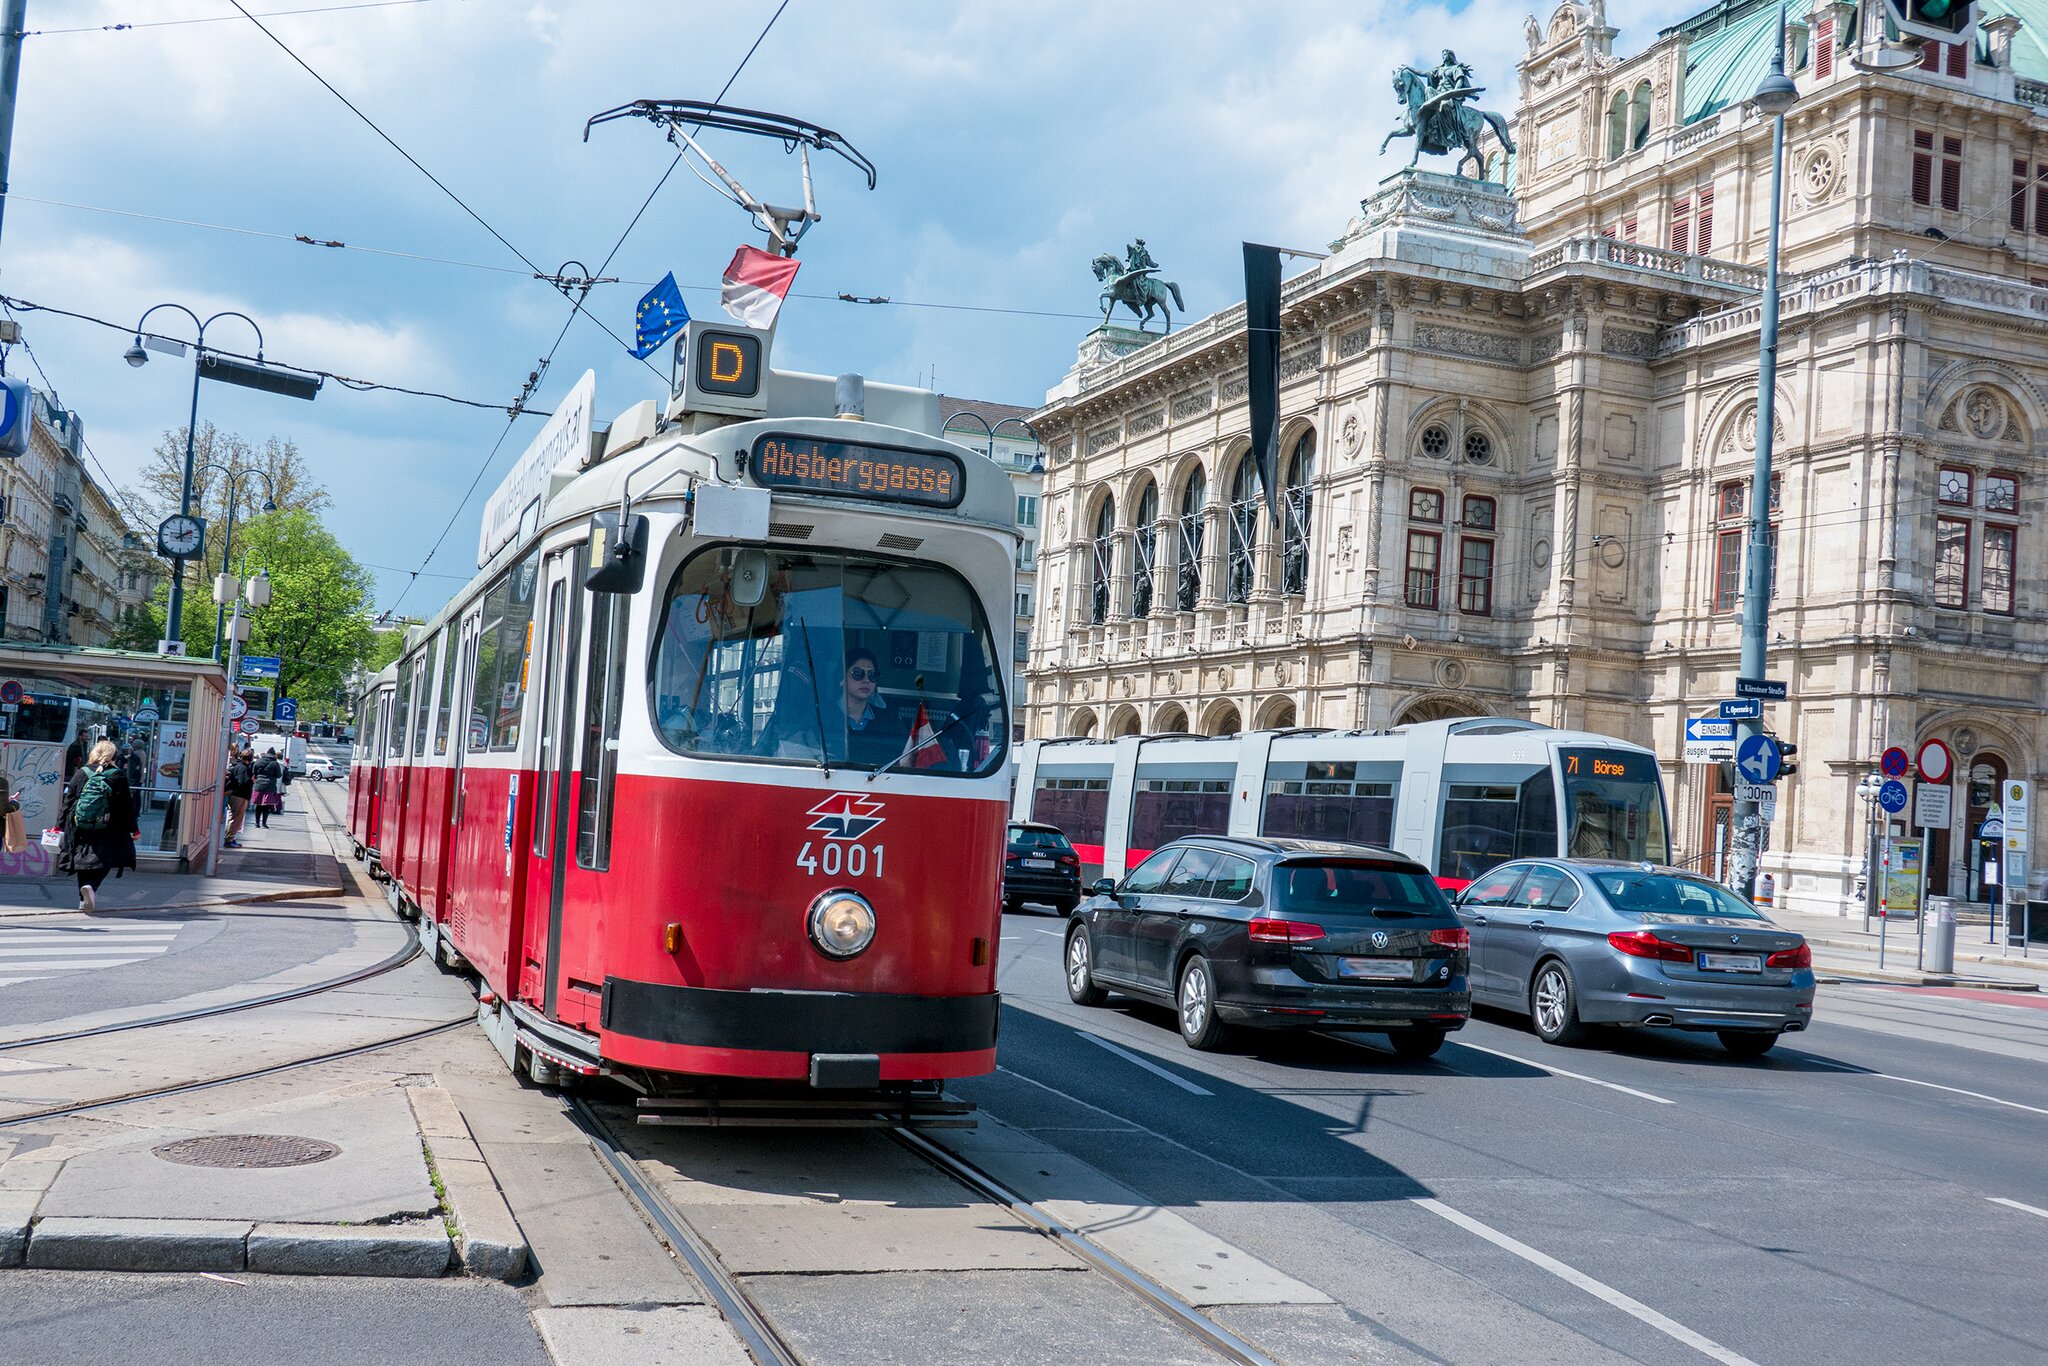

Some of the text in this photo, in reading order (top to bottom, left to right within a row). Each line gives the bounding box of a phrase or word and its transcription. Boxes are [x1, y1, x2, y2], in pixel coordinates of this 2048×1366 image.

[711, 342, 743, 382] D
[762, 441, 951, 494] Absberggasse
[1768, 686, 1785, 695] Straße
[282, 705, 291, 717] P
[1701, 725, 1731, 735] EINBAHN
[1686, 747, 1709, 758] ausgen.
[1567, 756, 1625, 776] 71 Börse
[1743, 786, 1772, 800] 00m
[796, 841, 884, 878] 4001
